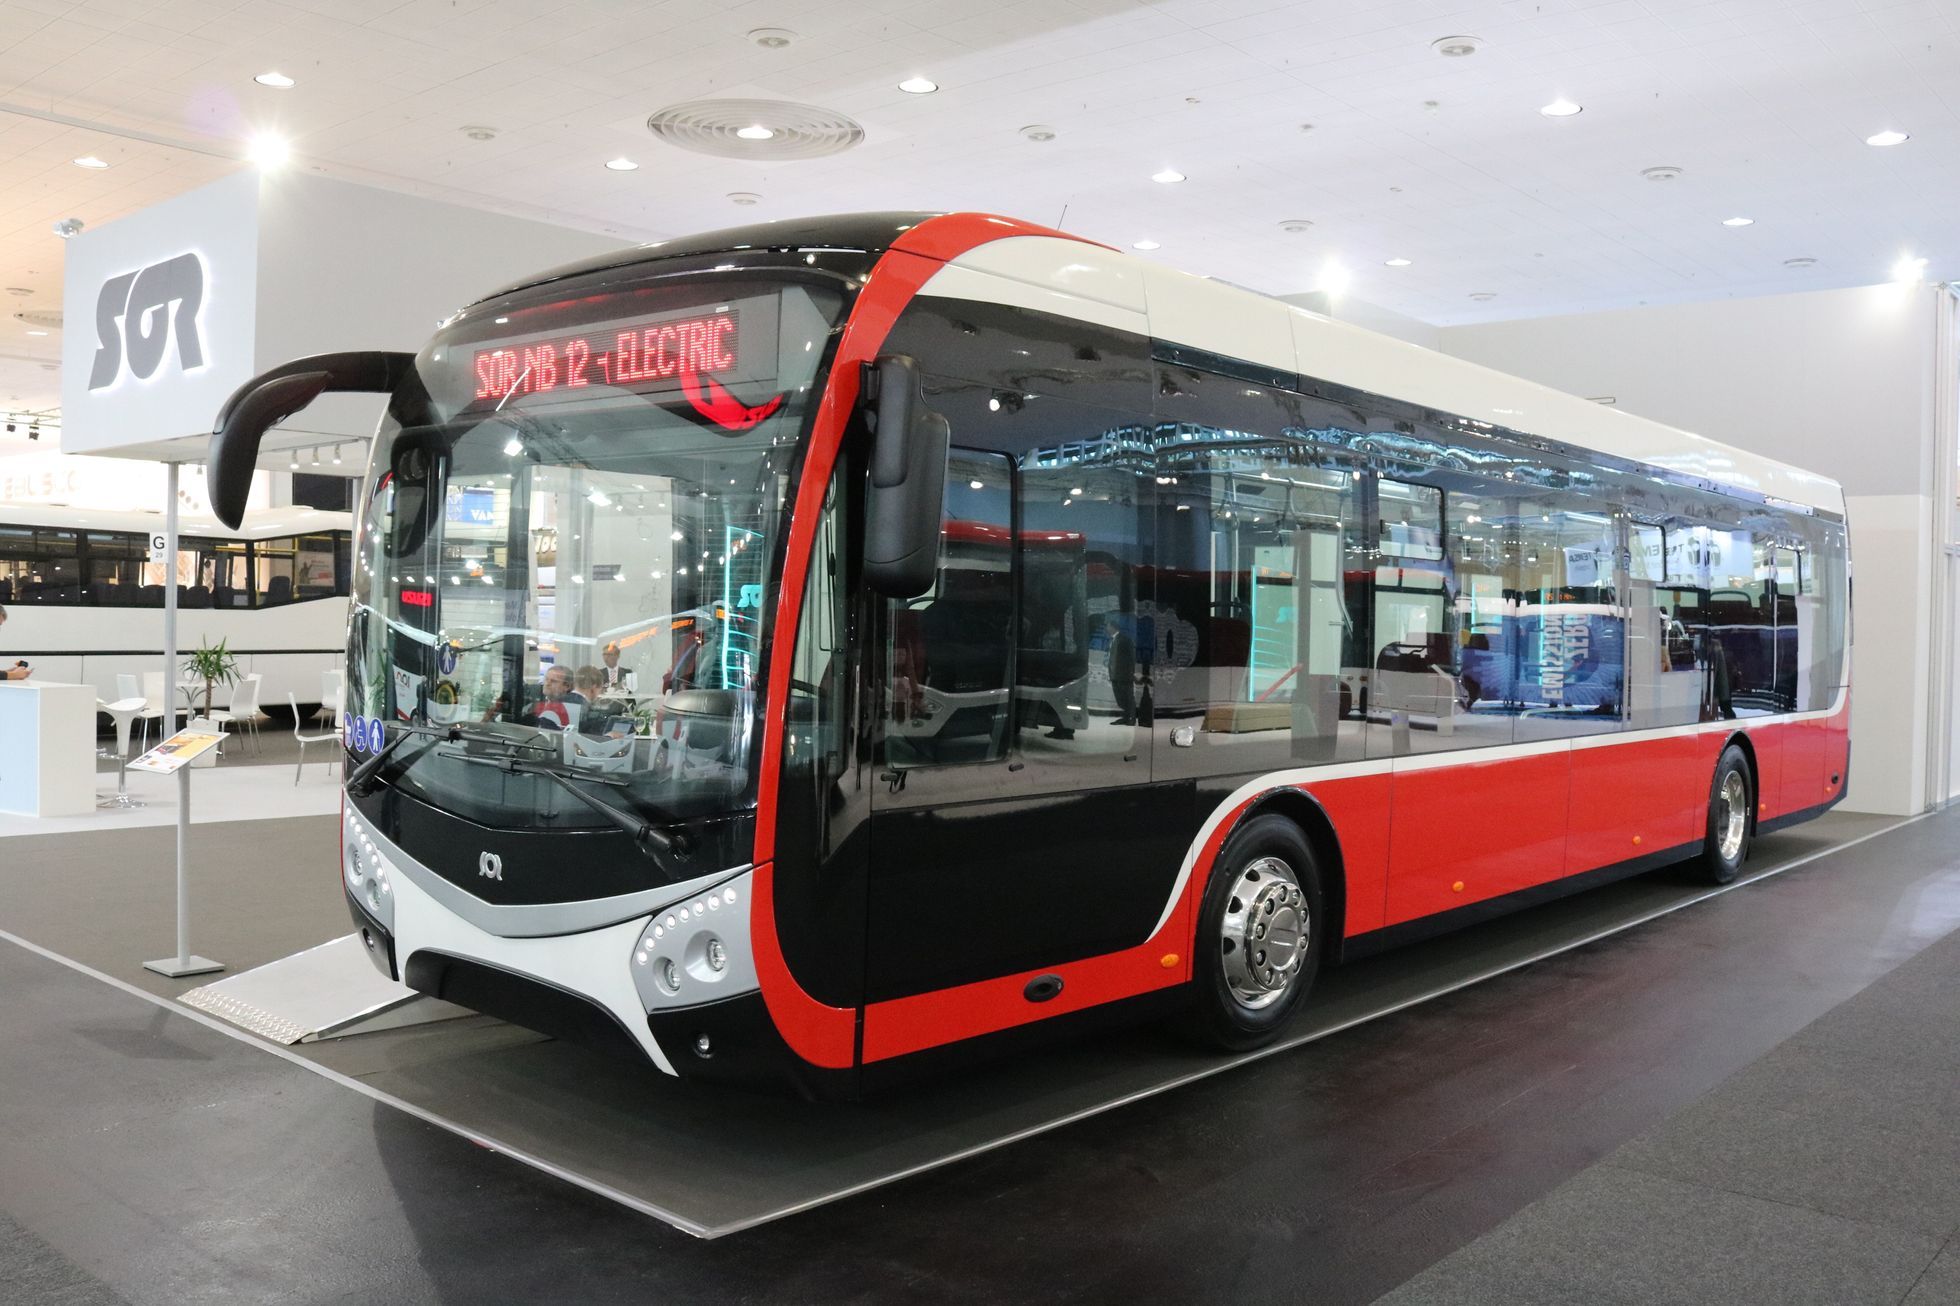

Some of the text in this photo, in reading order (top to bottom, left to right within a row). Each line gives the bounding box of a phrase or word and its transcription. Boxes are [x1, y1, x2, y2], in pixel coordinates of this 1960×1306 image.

[88, 252, 204, 391] SOR
[476, 351, 517, 398] SOR
[524, 344, 556, 393] NB
[565, 339, 590, 387] 12
[616, 318, 735, 382] ELECTRIC
[153, 535, 165, 549] G
[737, 585, 762, 608] SO
